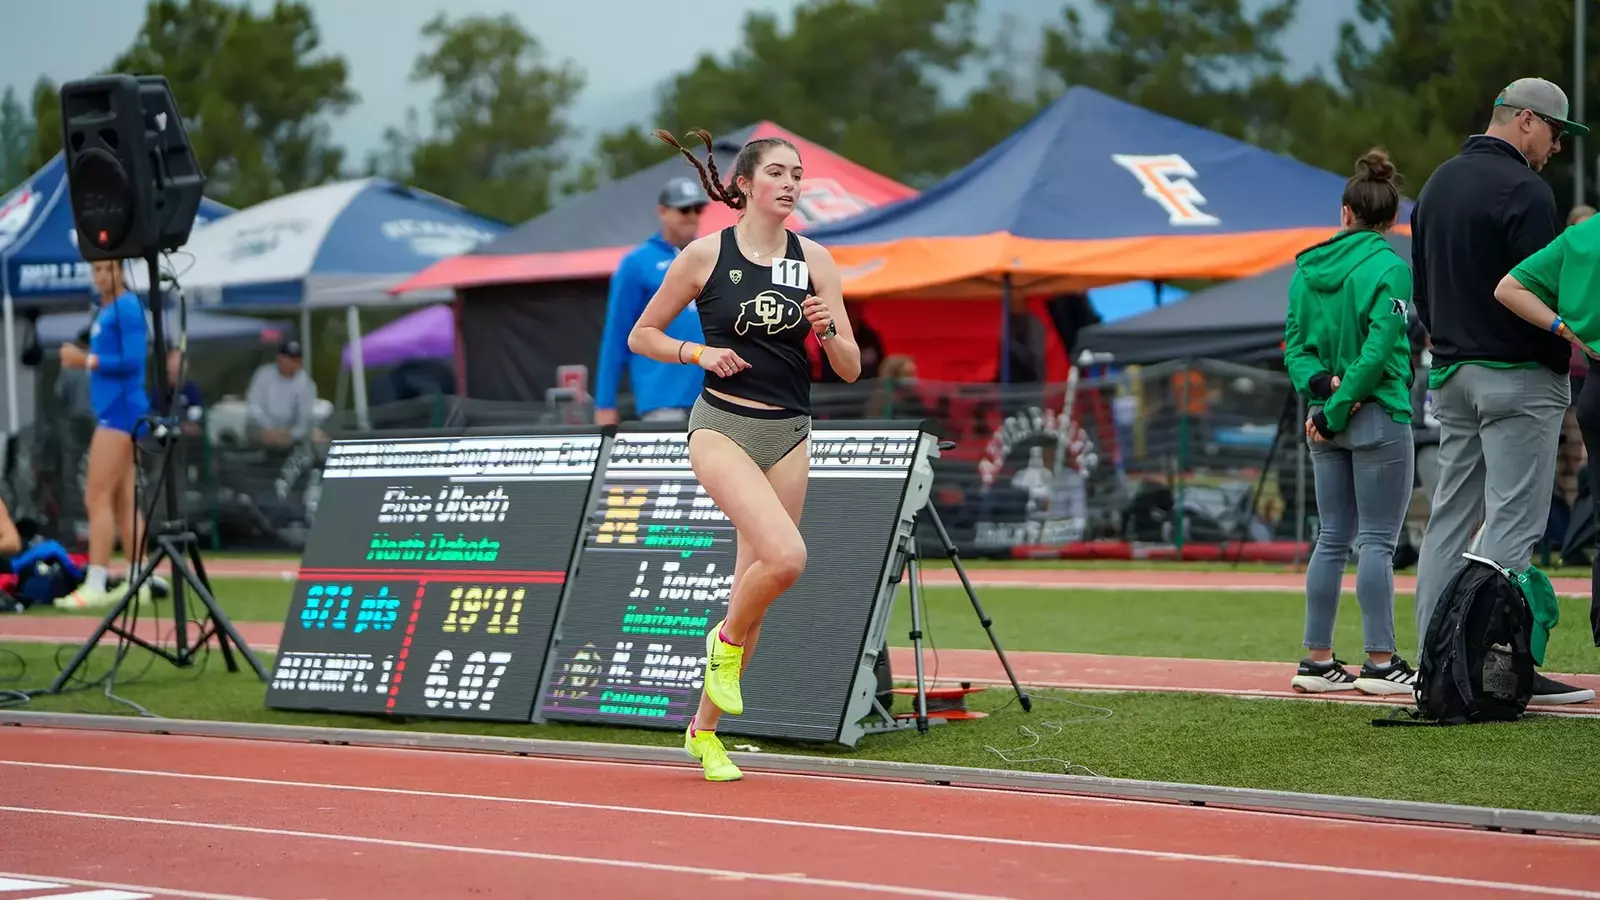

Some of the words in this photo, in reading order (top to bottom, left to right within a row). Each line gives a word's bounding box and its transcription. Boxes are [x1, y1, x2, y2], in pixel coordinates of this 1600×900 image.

[778, 260, 801, 287] 11
[755, 295, 785, 325] CU
[493, 444, 545, 475] Jump
[378, 486, 432, 523] Elise
[366, 532, 426, 561] North
[425, 532, 500, 562] Dakota
[353, 585, 401, 634] pts
[424, 649, 513, 710] 6.07
